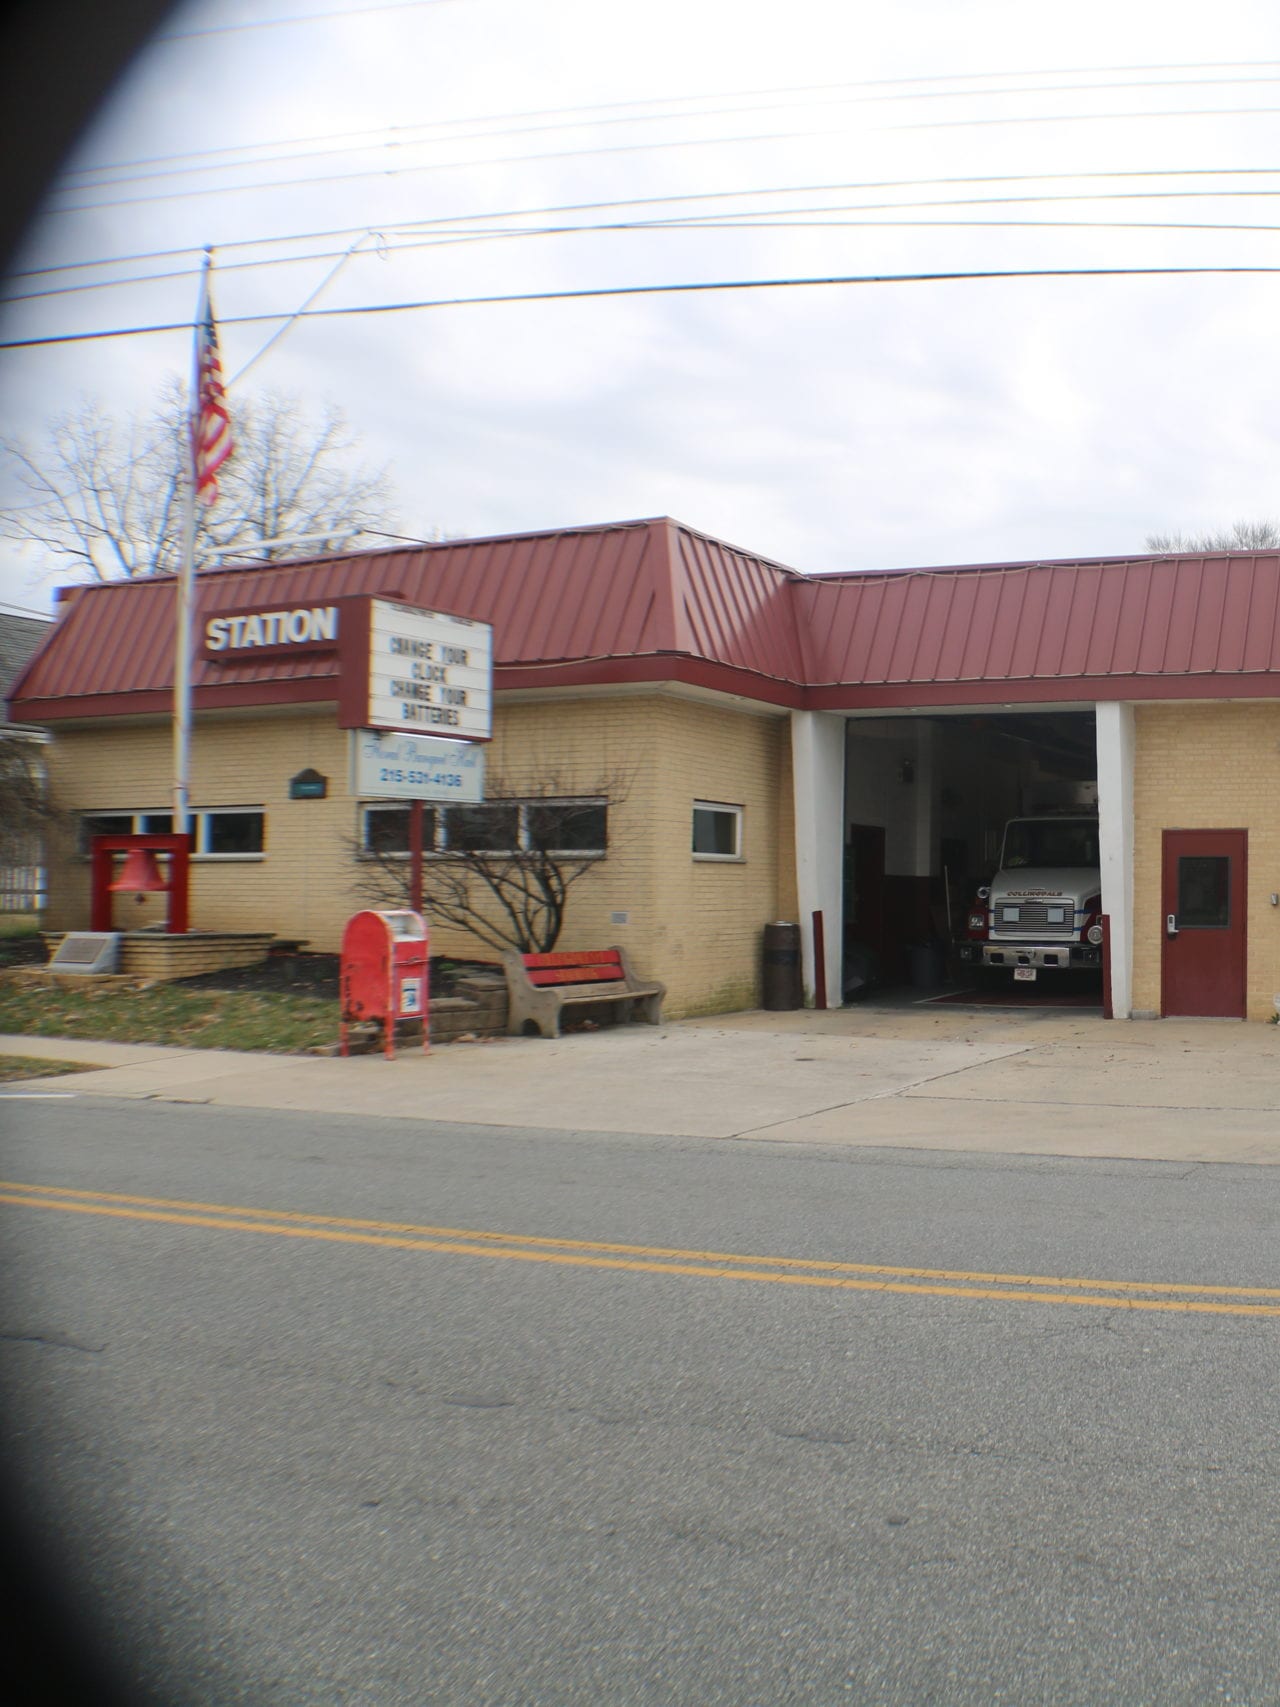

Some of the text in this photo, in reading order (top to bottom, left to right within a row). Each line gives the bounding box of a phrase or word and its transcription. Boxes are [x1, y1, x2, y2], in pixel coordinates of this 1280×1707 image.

[205, 606, 338, 651] STATION
[389, 636, 468, 666] CHANGE YOUR
[411, 662, 446, 684] CLOCK
[390, 679, 466, 706] CHANGE YOUR
[402, 703, 459, 726] BATTERIES
